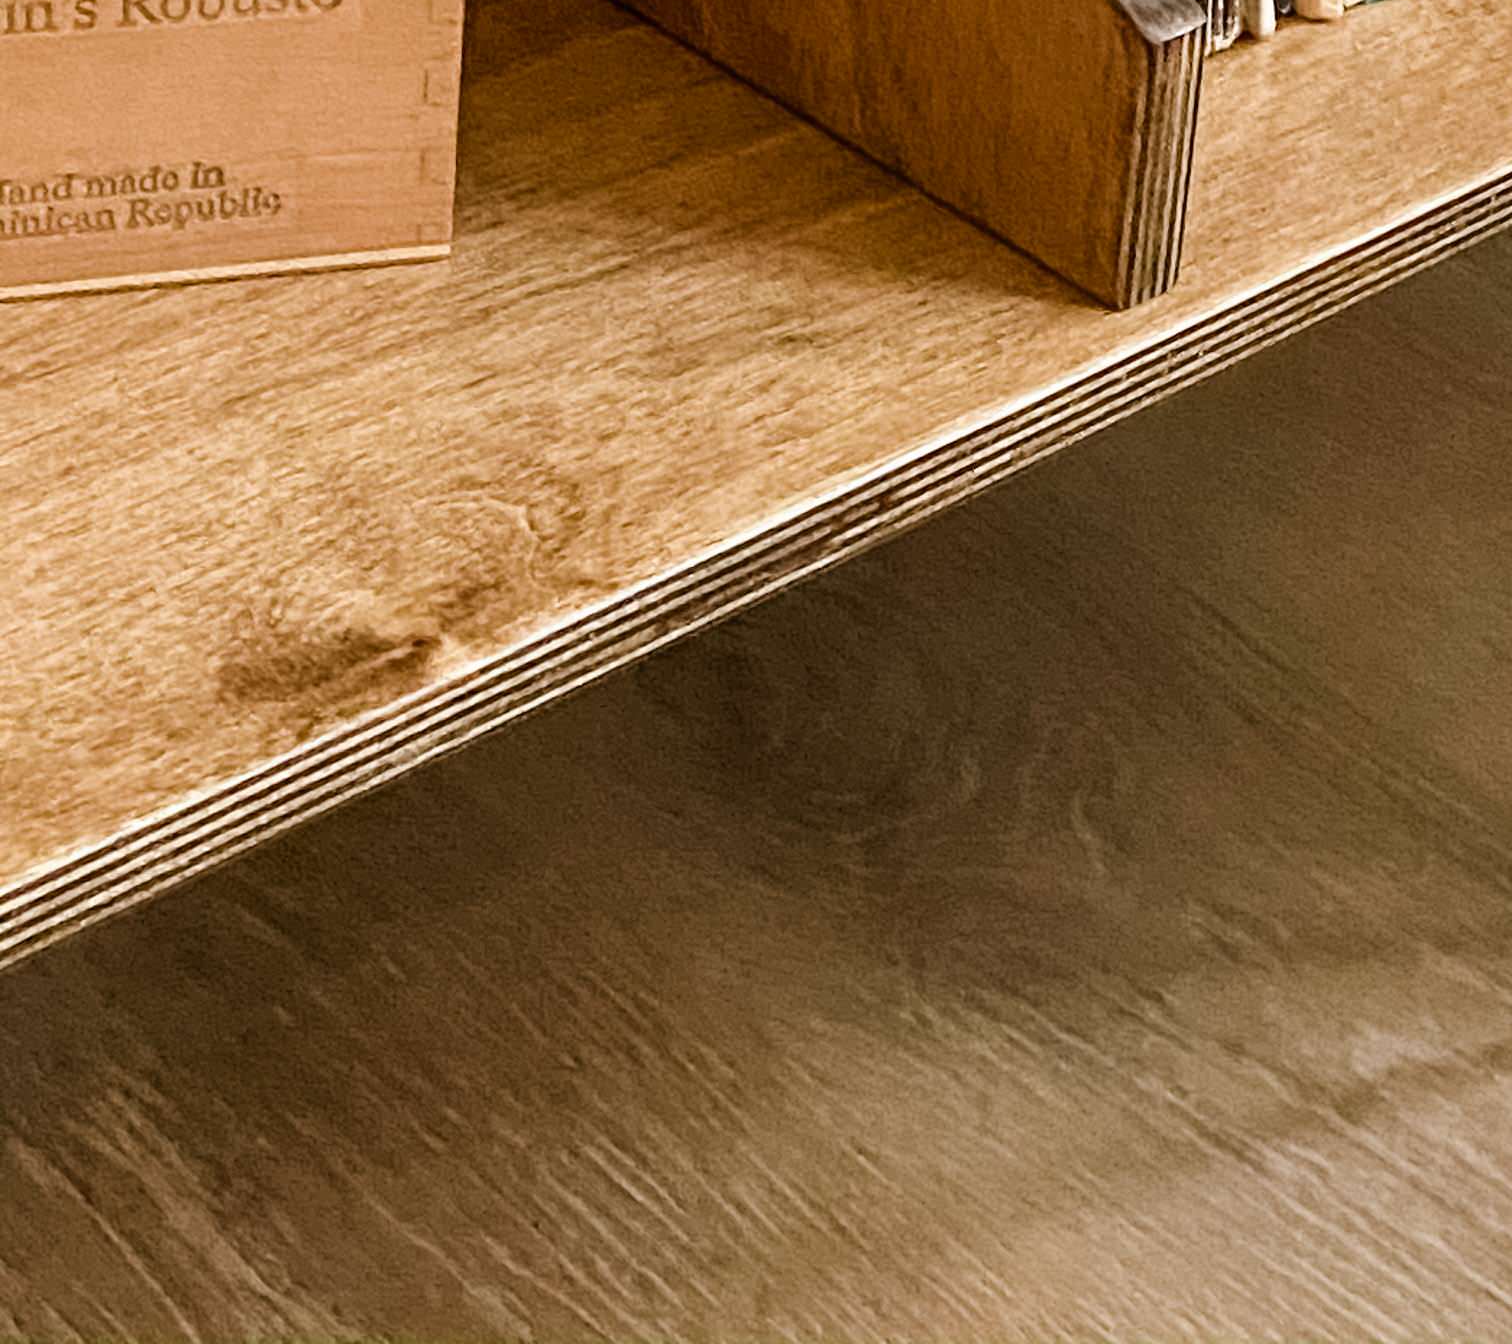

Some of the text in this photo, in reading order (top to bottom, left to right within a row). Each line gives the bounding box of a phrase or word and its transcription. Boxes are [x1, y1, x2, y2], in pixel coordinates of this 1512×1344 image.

[84, 165, 179, 199] made
[190, 161, 226, 190] in
[126, 186, 282, 230] Republic
